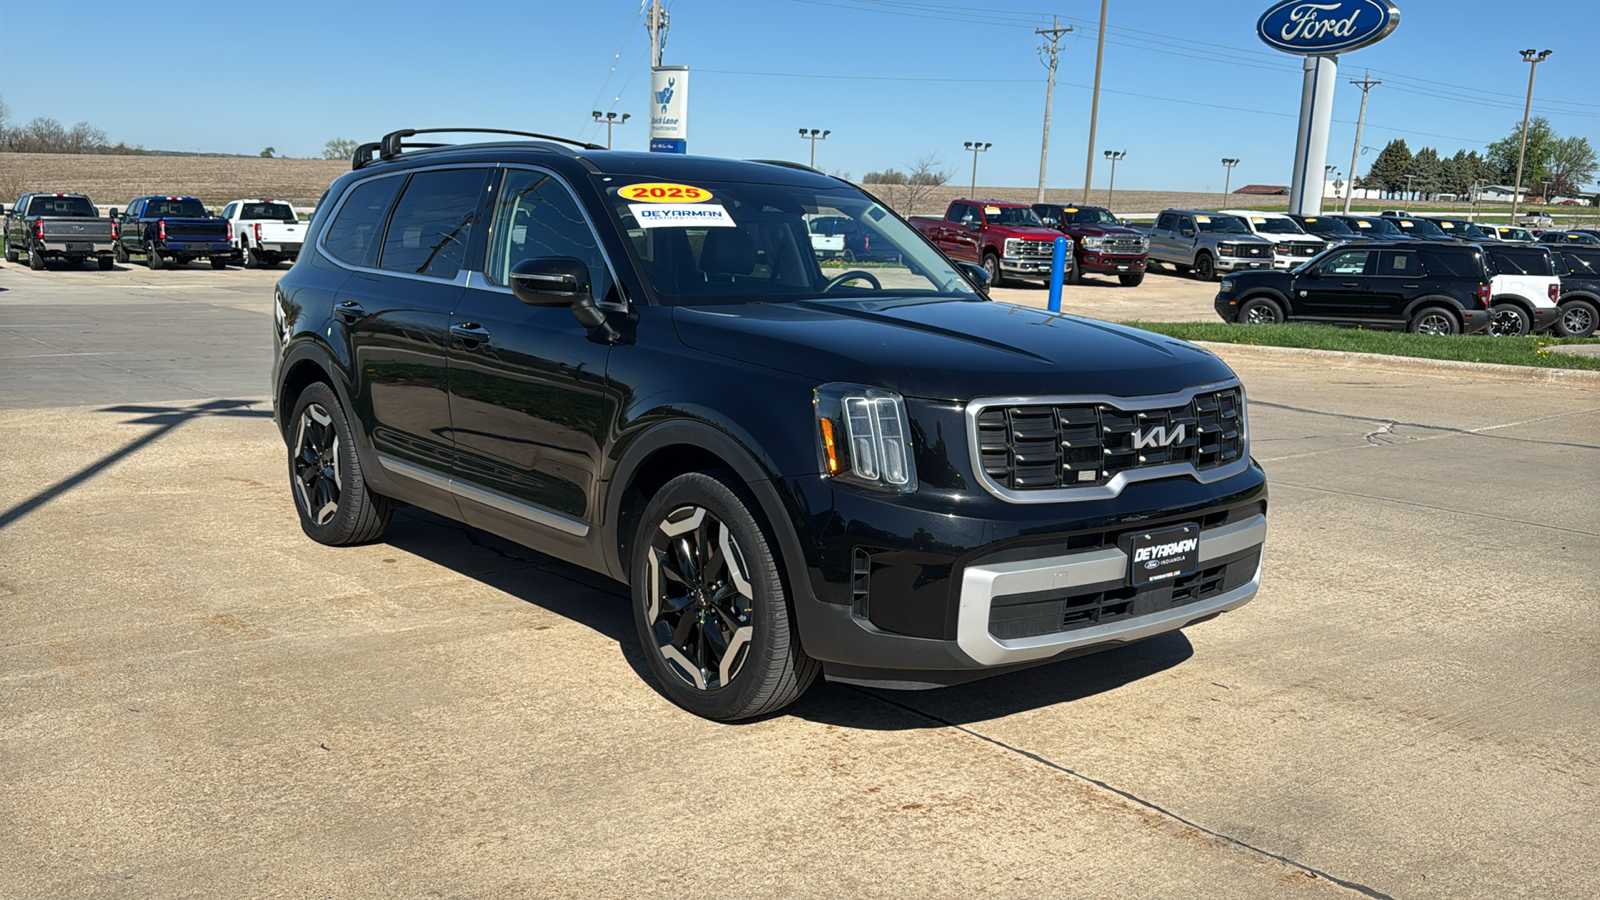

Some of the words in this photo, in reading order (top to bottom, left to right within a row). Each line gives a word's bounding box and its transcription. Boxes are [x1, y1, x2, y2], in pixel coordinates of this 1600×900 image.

[1281, 3, 1361, 41] Ford
[632, 187, 701, 198] 2025
[1134, 423, 1185, 449] KIA
[1134, 538, 1198, 562] DEYARMAN
[1161, 555, 1186, 565] INDIANOLA
